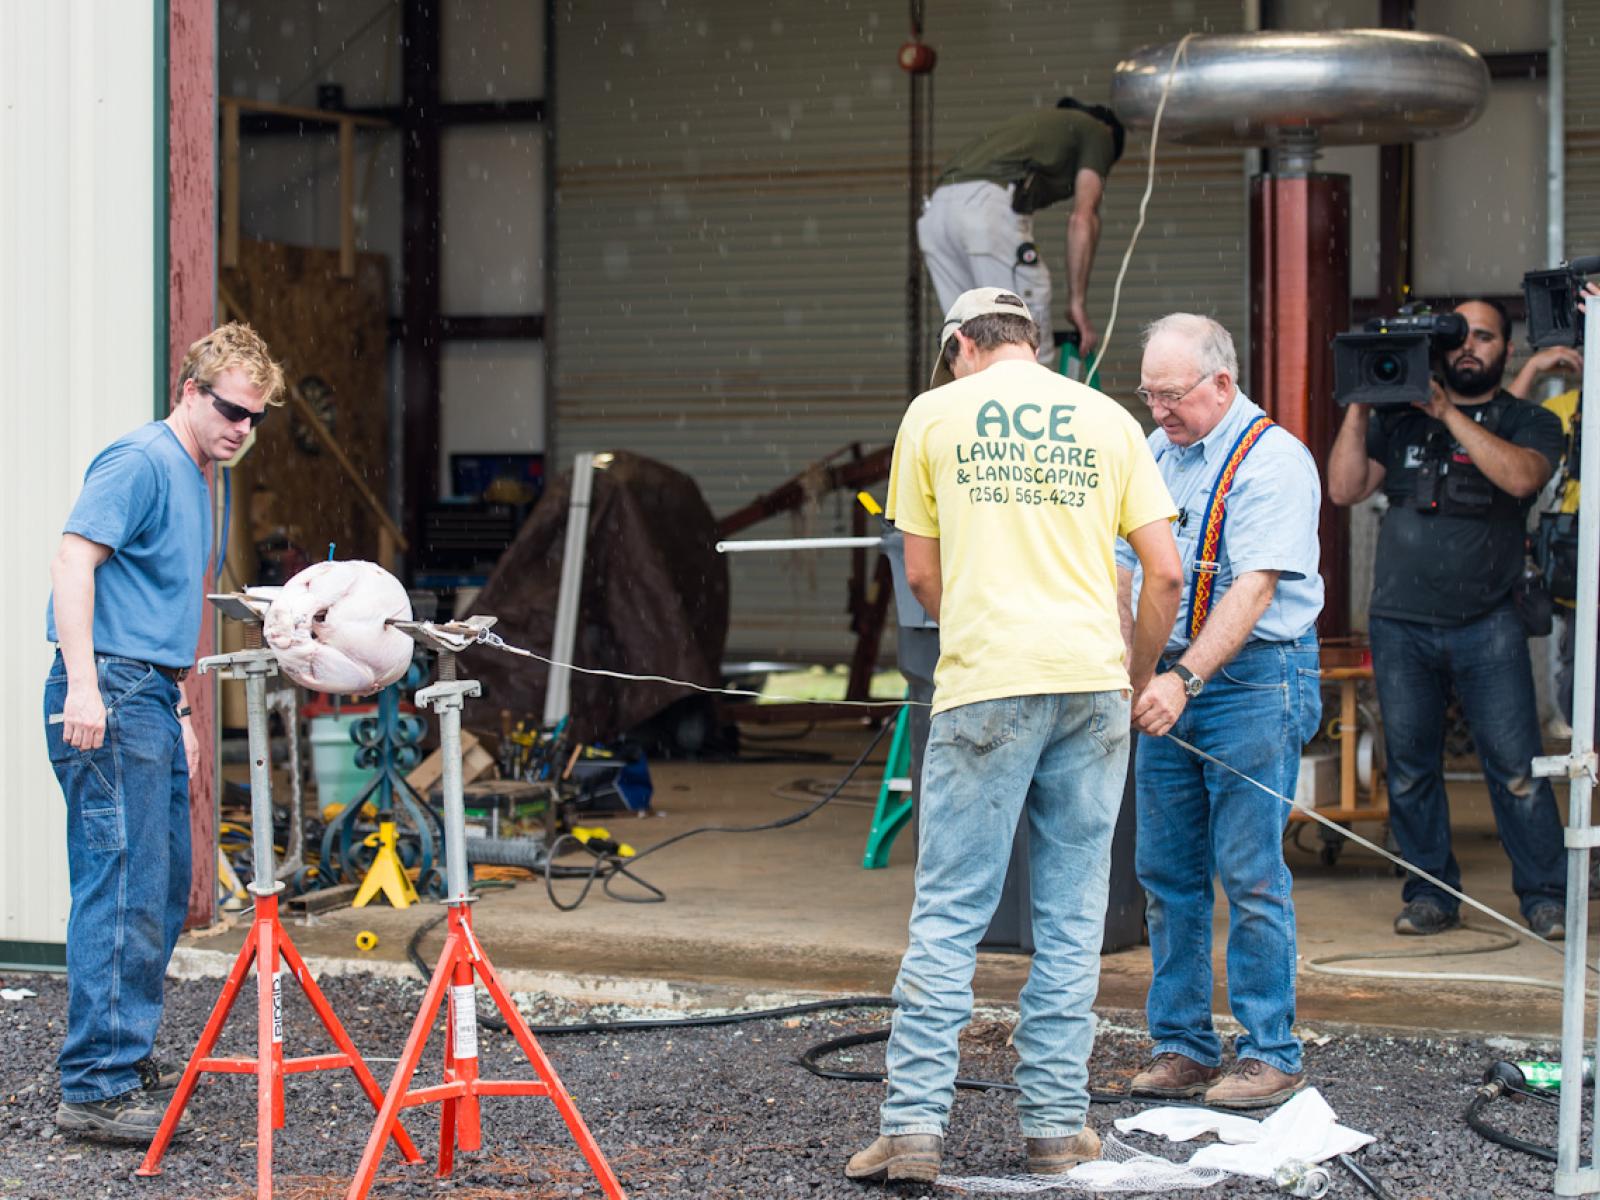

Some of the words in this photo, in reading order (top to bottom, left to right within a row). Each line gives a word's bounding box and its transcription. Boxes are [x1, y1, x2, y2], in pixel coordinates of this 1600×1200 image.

[977, 400, 1076, 443] ACE
[956, 442, 1026, 464] LAWN
[1034, 444, 1097, 468] CARE
[957, 469, 971, 484] &
[976, 465, 1099, 488] LANDSCAPING
[969, 487, 1009, 504] (256)
[1016, 487, 1086, 507] 565-4223
